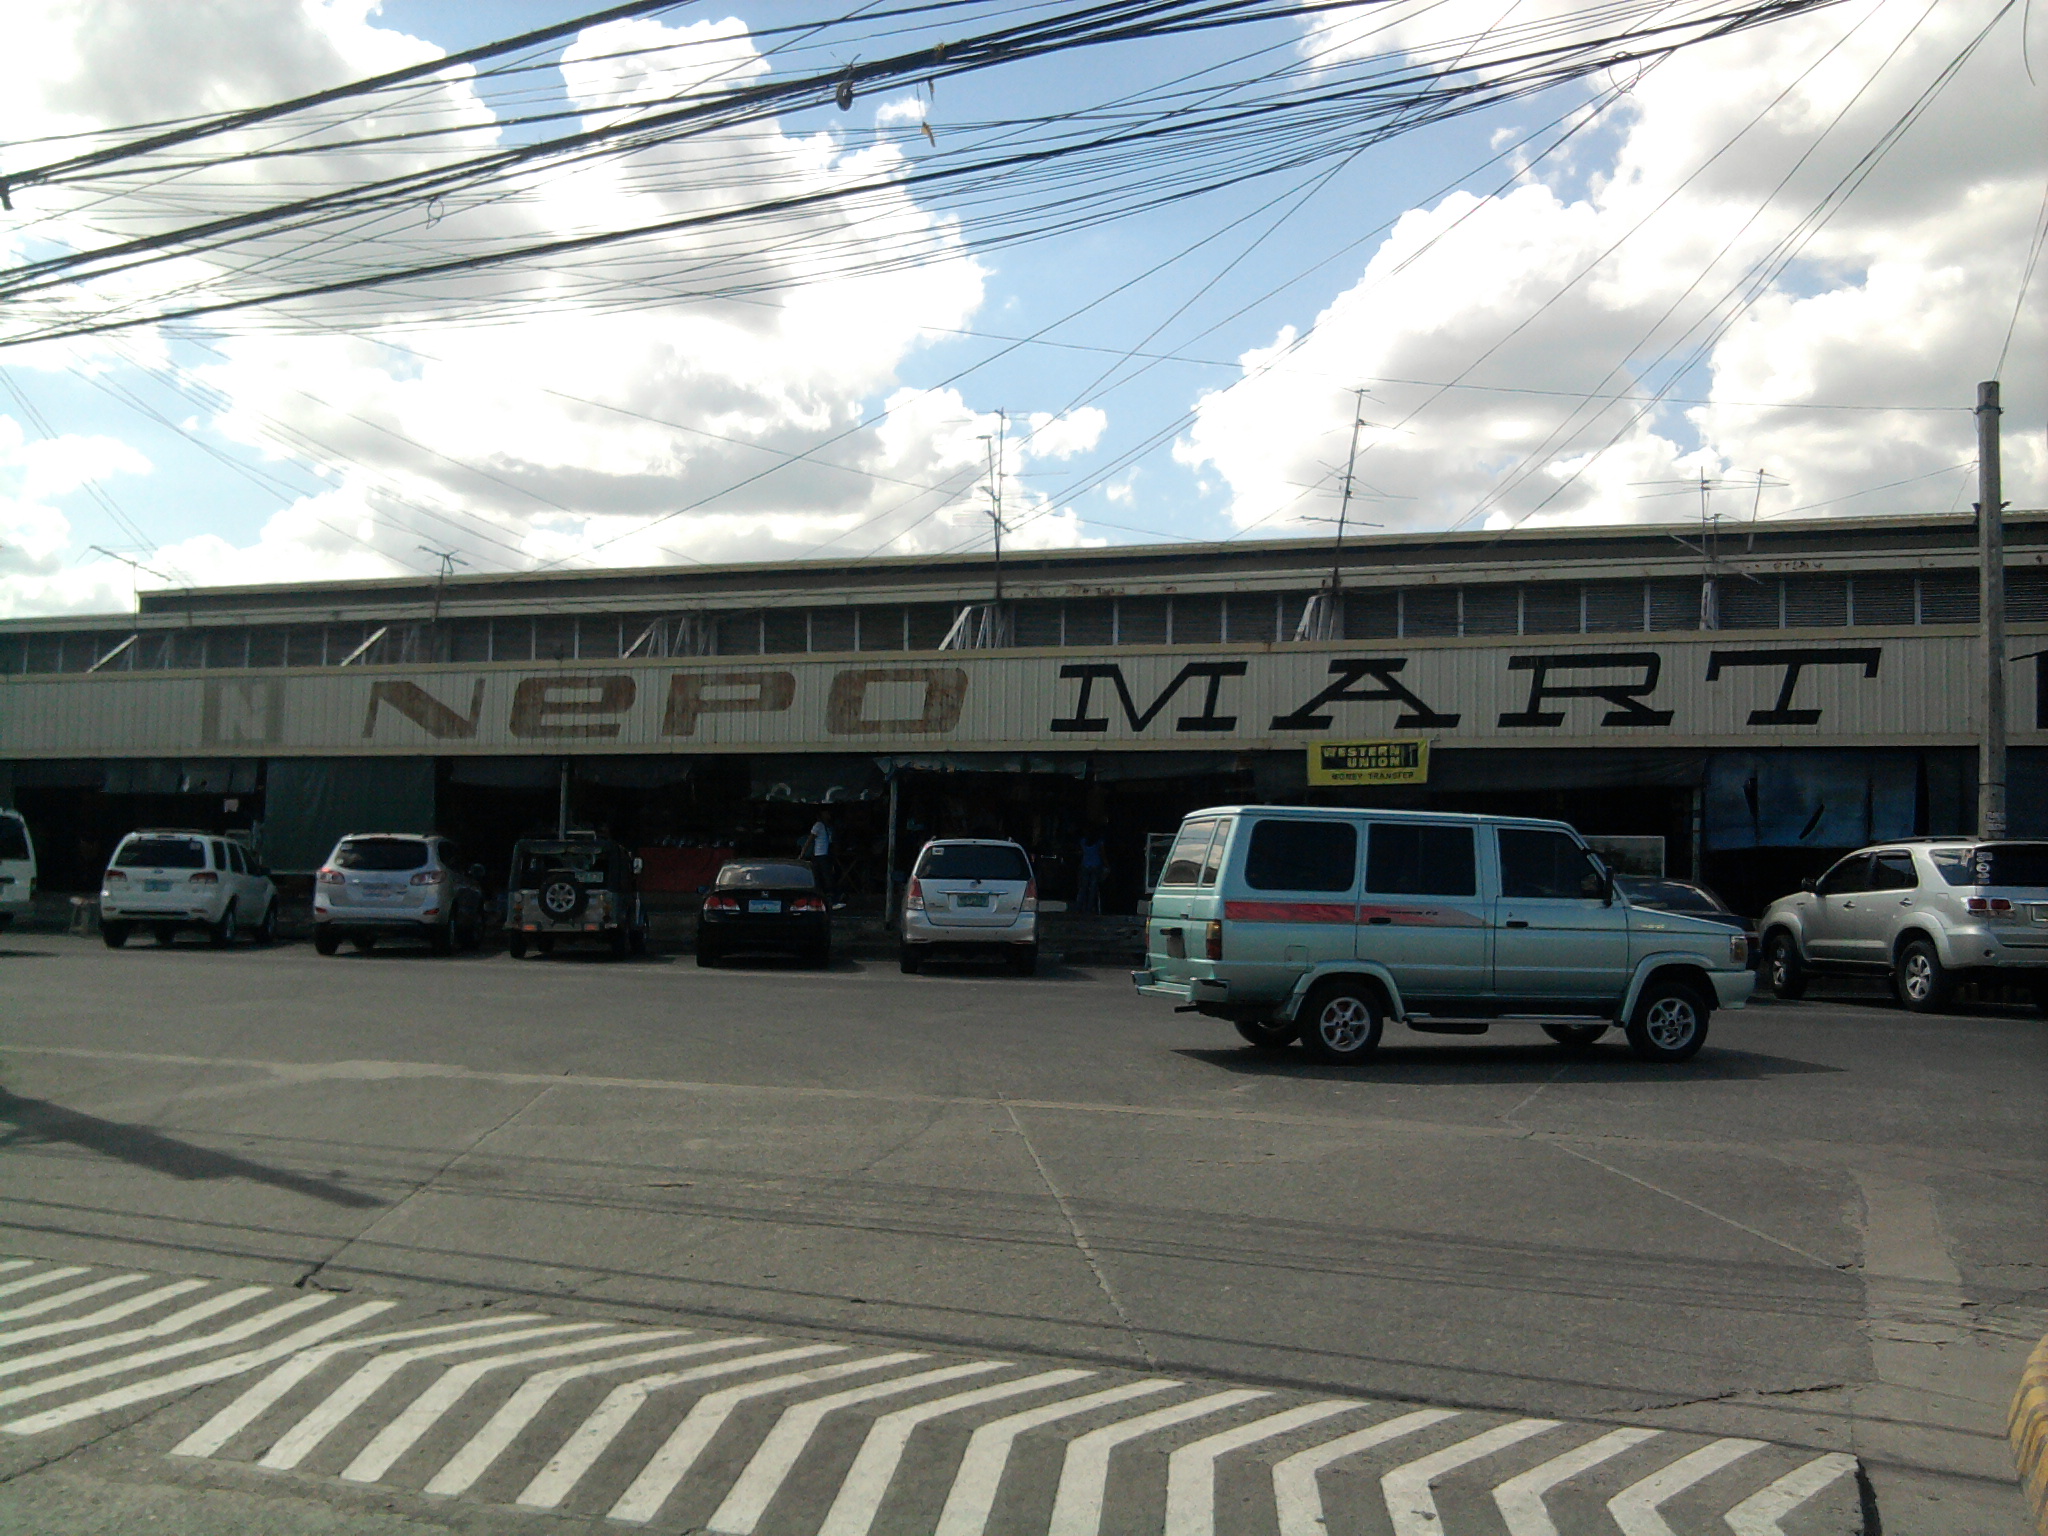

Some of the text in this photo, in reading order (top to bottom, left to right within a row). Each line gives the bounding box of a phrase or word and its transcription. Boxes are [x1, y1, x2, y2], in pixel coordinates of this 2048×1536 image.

[1051, 647, 1883, 732] MART
[1323, 745, 1401, 757] WESTERN
[1346, 757, 1401, 768] UNION
